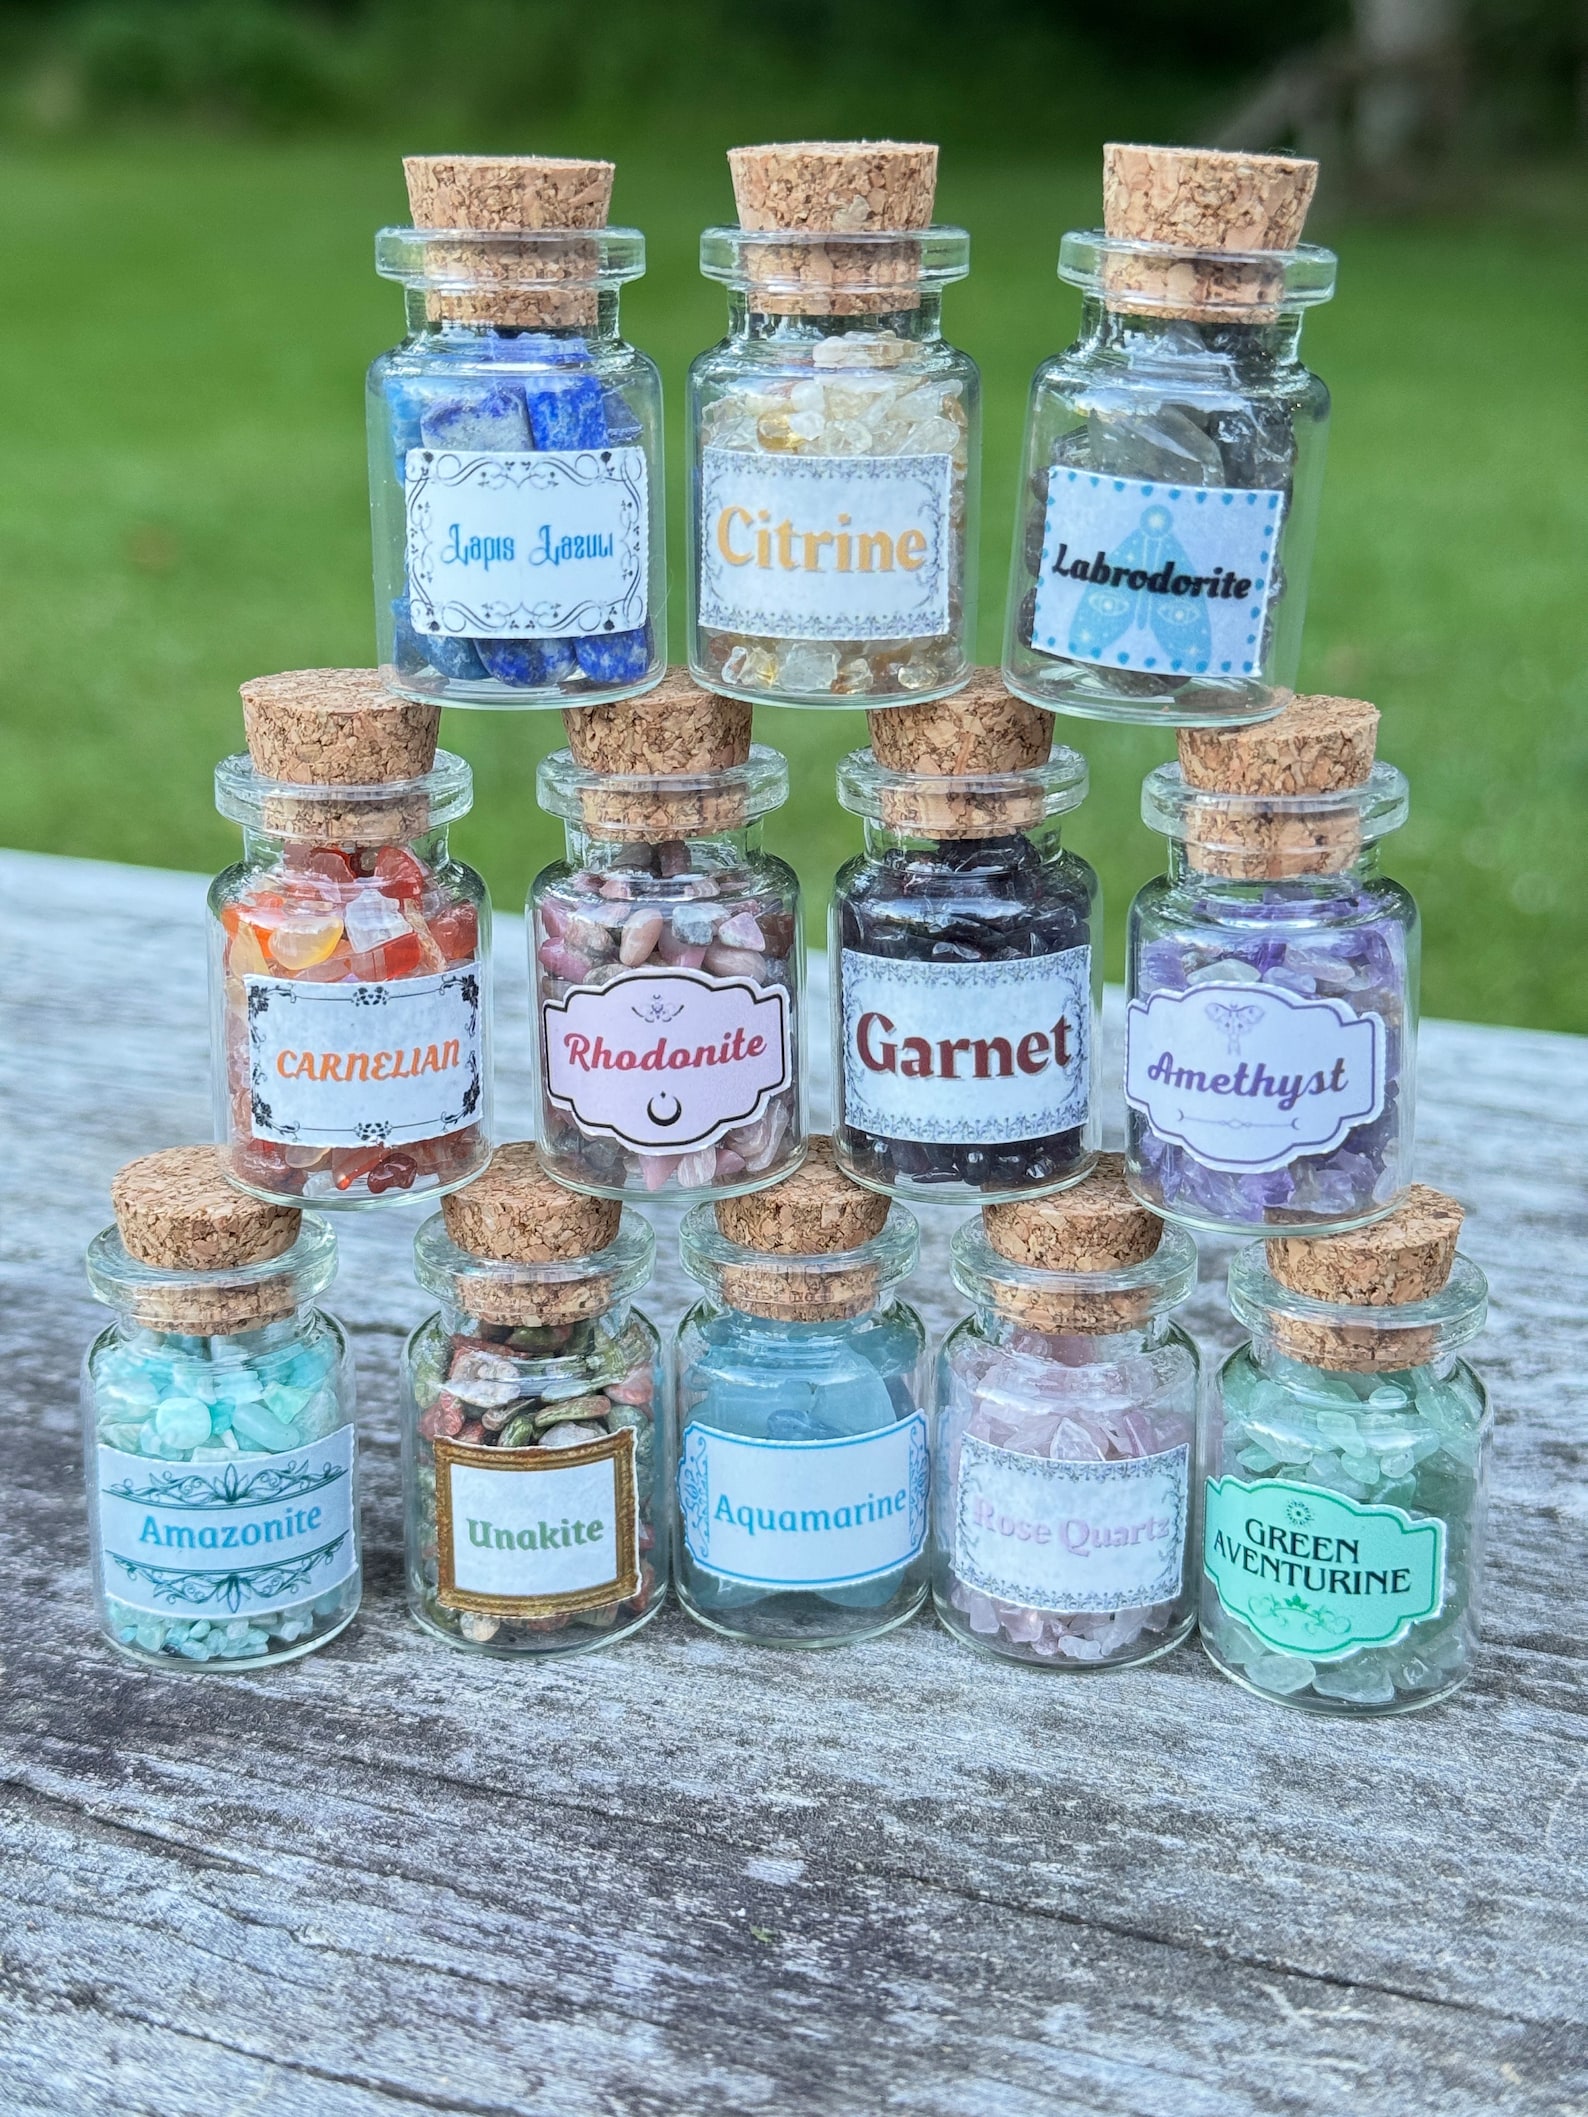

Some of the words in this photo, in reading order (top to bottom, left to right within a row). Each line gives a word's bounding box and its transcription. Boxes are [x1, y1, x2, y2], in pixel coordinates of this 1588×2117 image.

[440, 523, 514, 571] Lapis
[528, 524, 612, 565] Lazuli
[717, 505, 927, 573] Citrine
[1051, 544, 1252, 601] Labrodorite
[276, 1039, 459, 1082] CARNELIAN
[563, 1027, 766, 1071] Rhodonite
[856, 1012, 1072, 1079] Garnet
[1147, 1052, 1347, 1112] Amethyst
[139, 1505, 321, 1551] Amazonite
[466, 1518, 604, 1552] Unakite
[713, 1489, 906, 1536] Aquamarine
[974, 1494, 1051, 1543] Rose
[1060, 1516, 1170, 1558] Quartz
[1213, 1529, 1411, 1595] AVENTURINE
[1245, 1518, 1358, 1563] GREEN
